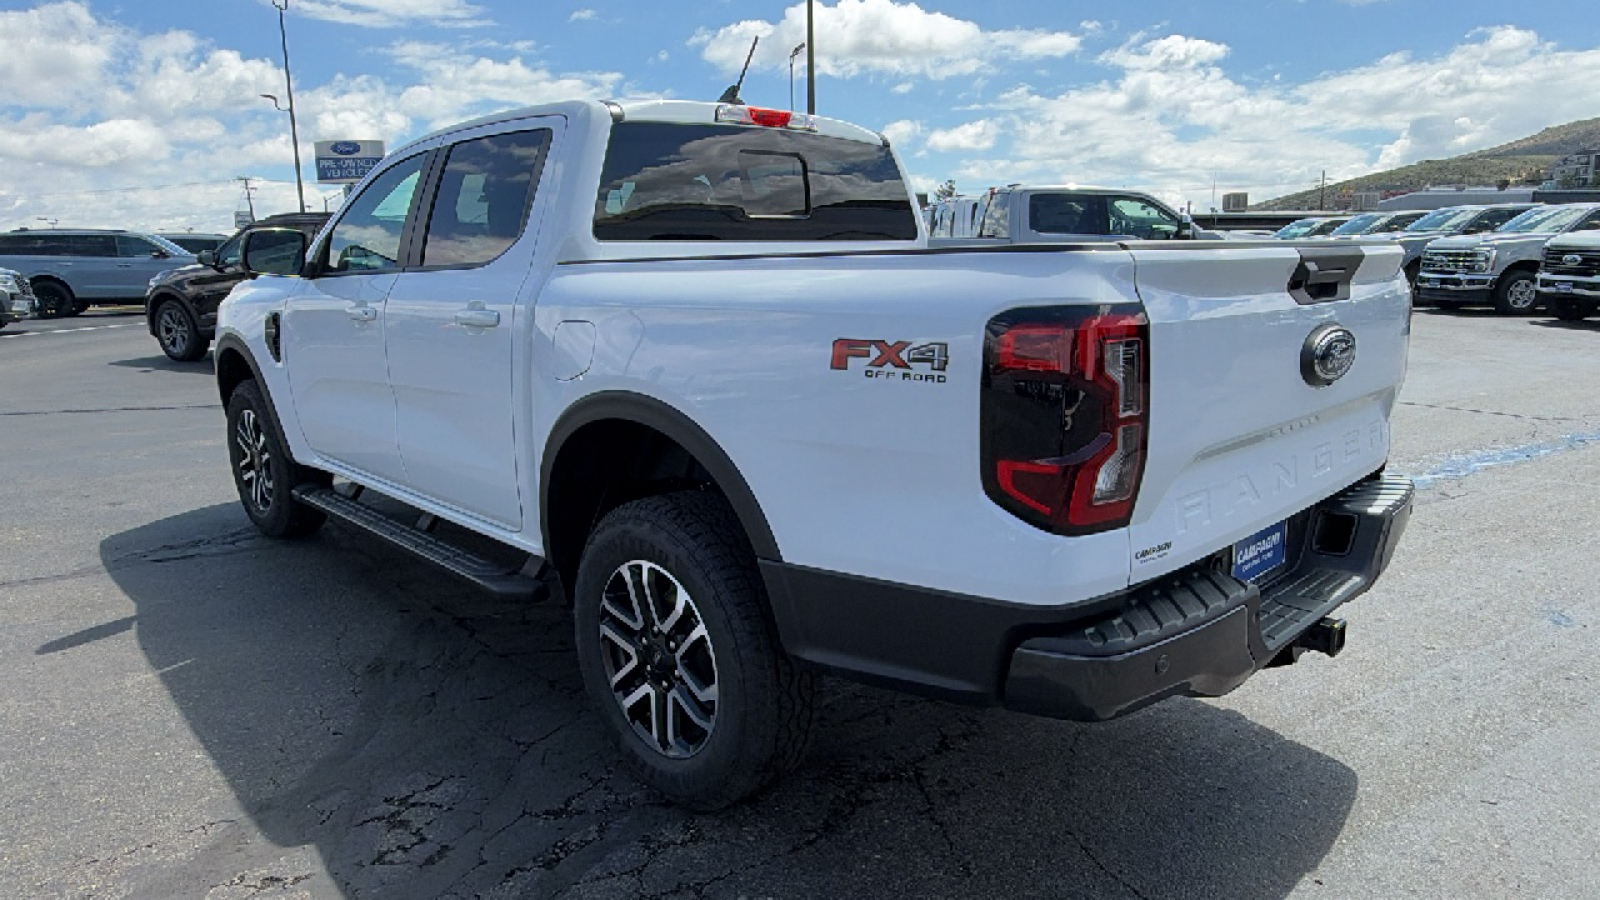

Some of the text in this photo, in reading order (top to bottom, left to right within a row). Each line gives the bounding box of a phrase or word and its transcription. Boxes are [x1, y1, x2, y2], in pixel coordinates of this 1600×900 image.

[319, 158, 377, 168] PRE-OWNED
[325, 168, 370, 177] VEHICLES
[830, 338, 949, 371] FX4
[864, 370, 947, 383] OFF ROAD
[1174, 420, 1384, 535] RANGER
